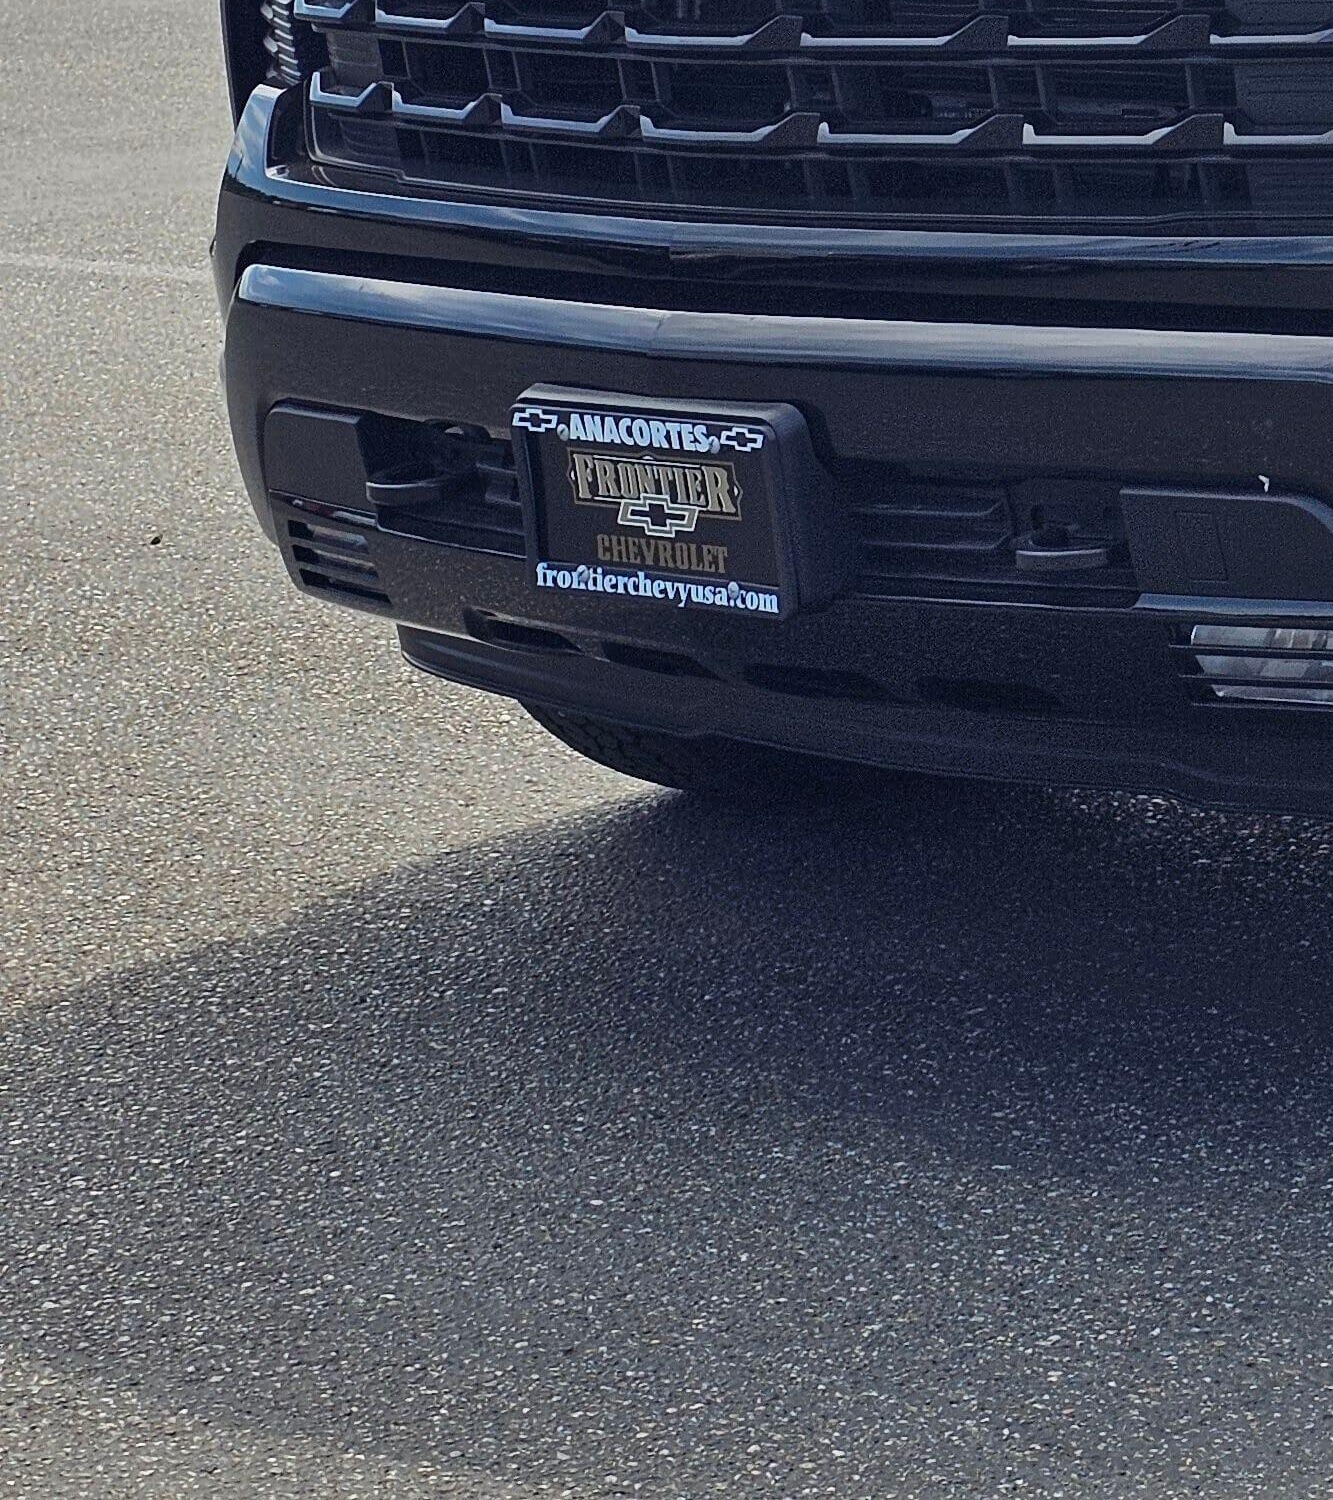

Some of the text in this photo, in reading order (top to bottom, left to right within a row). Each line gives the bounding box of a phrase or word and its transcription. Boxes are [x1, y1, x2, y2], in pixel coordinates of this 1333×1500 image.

[568, 413, 711, 453] ANACORTES
[573, 453, 737, 514] FRONTIER
[596, 533, 728, 574] CHEVROLET
[536, 562, 779, 614] frontierchevyusa.com
